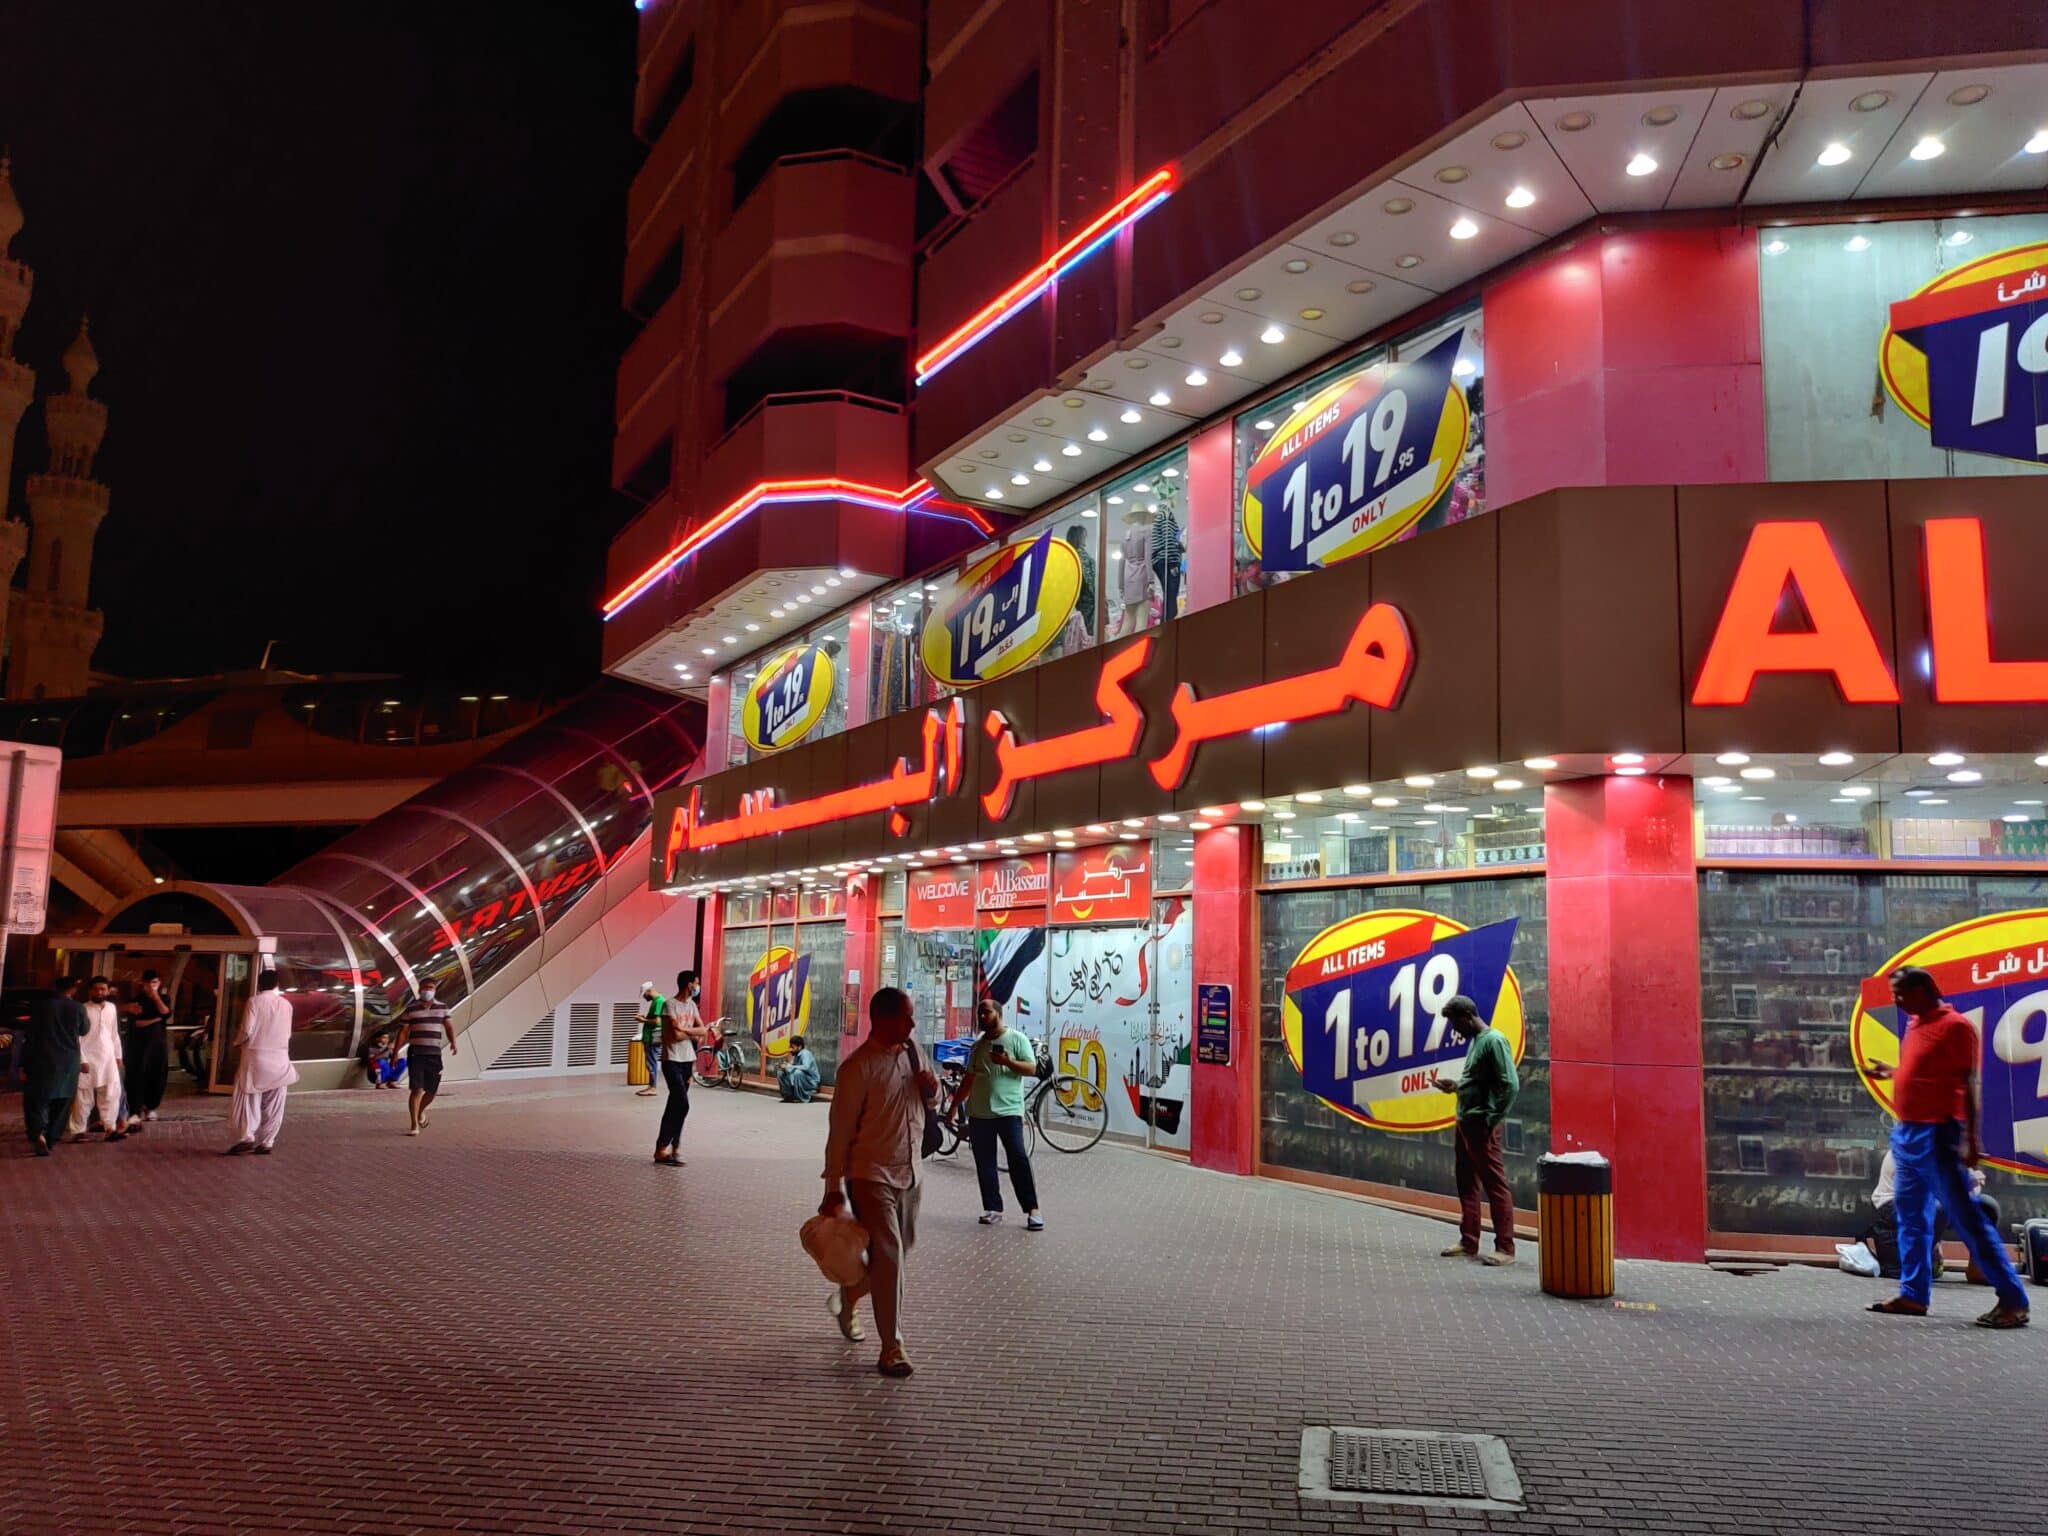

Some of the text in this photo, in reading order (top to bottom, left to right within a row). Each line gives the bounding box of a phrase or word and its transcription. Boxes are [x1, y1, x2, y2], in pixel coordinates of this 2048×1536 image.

[1280, 402, 1341, 461] ALL ITEMS
[1283, 461, 1307, 551] 1
[1310, 483, 1343, 532] to
[1352, 498, 1387, 534] ONLY
[1691, 517, 2048, 705] AL
[664, 602, 1415, 883] مركز البسام
[991, 869, 1047, 893] Al Bassam
[1083, 860, 1146, 884] مركز
[917, 880, 969, 901] WELCOME
[981, 887, 1017, 908] Centre
[1054, 879, 1131, 906] البسام
[1321, 940, 1386, 976] ALL ITEMS
[1325, 988, 1351, 1081] 1
[1355, 1027, 1390, 1072] to
[1057, 1037, 1107, 1112] 50
[1401, 1068, 1439, 1093] ONLY
